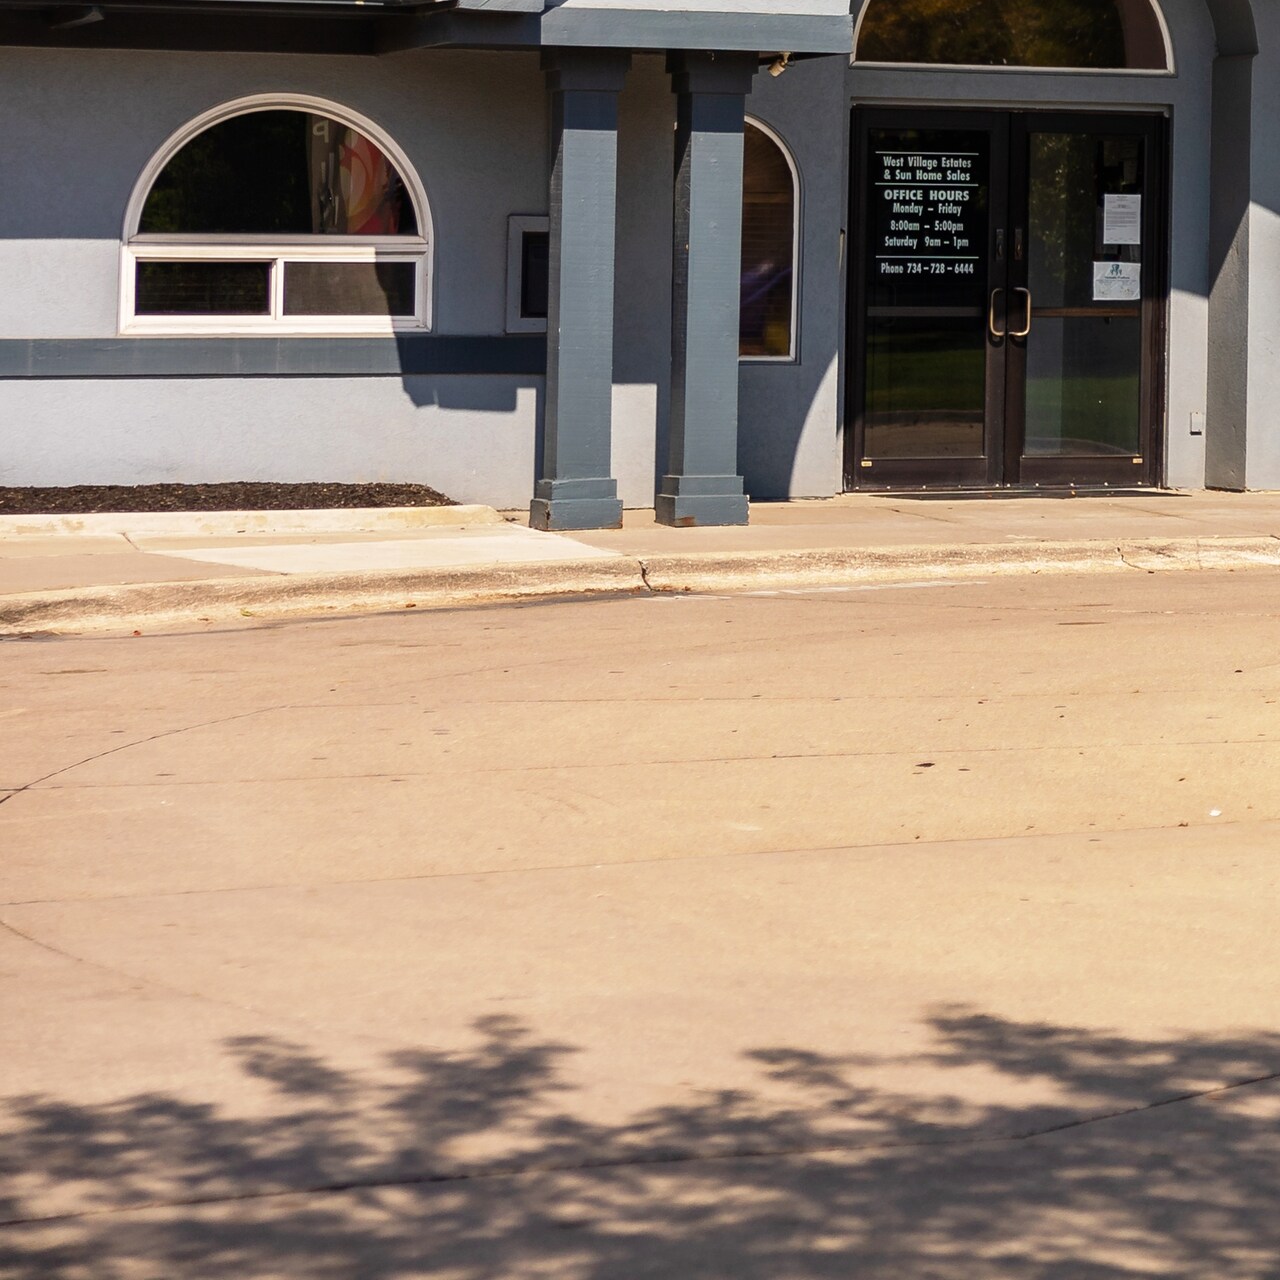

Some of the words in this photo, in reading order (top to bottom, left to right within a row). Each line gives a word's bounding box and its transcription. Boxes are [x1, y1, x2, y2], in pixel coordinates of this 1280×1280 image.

[883, 156, 904, 167] West
[908, 156, 938, 170] Village
[941, 157, 972, 168] Estates
[883, 169, 891, 180] &
[895, 169, 912, 180] Sun
[916, 169, 942, 180] Home
[946, 170, 970, 181] Sales
[884, 189, 923, 200] OFFICE
[929, 190, 970, 201] HOURS
[892, 202, 923, 216] Monday
[938, 202, 962, 217] Friday
[890, 220, 920, 231] 8:00am
[934, 220, 964, 234] 5:00pm
[884, 235, 918, 249] Saturday
[924, 236, 941, 247] 9am
[953, 236, 969, 249] 1pm
[880, 262, 904, 274] Phone
